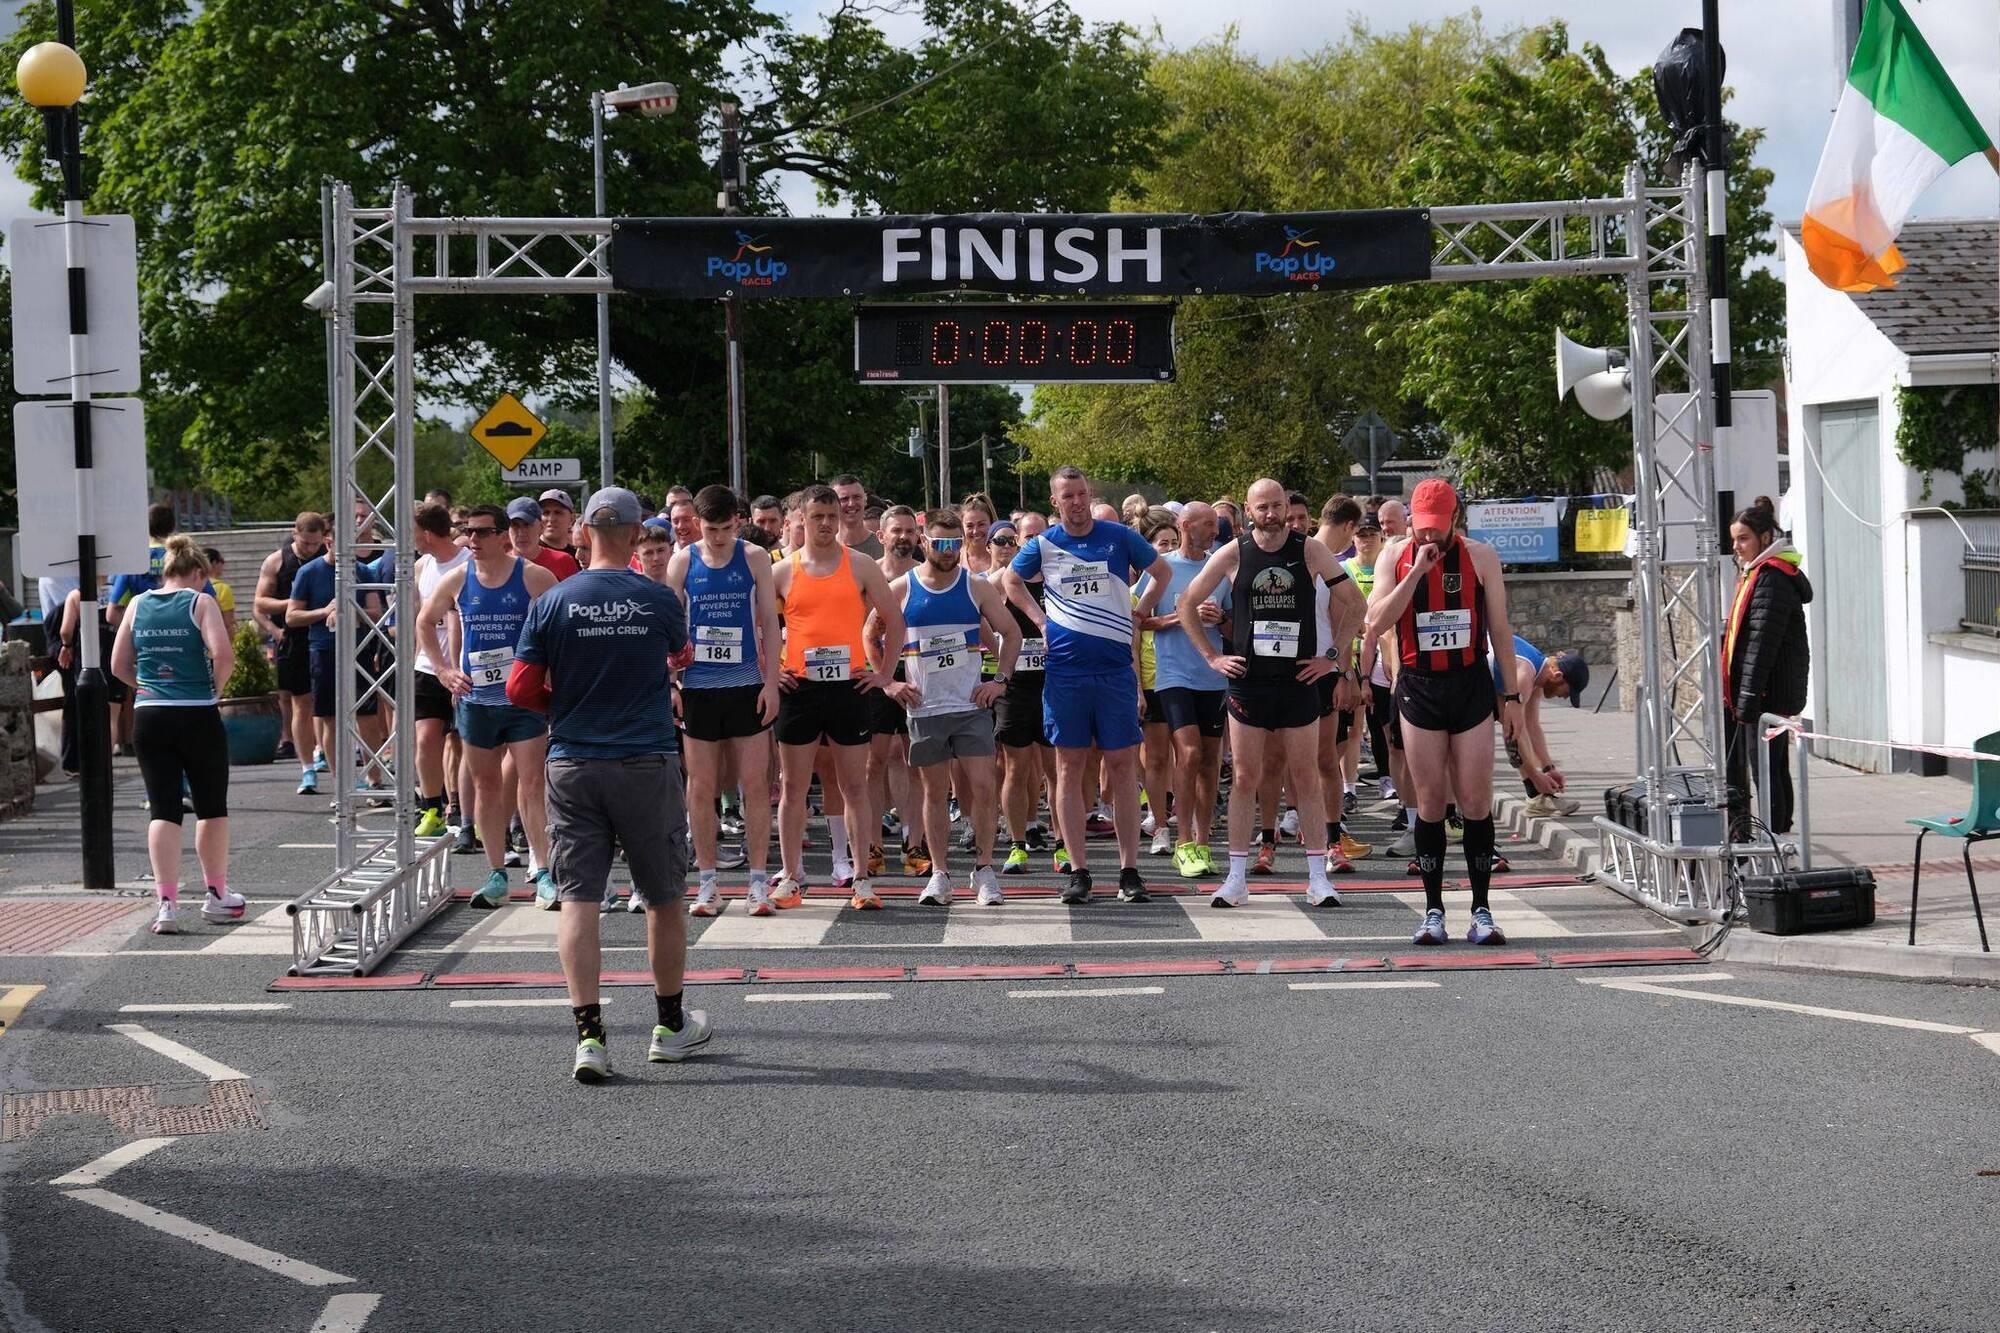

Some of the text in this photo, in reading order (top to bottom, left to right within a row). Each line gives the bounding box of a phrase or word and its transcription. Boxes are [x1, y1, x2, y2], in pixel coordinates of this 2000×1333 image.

[882, 227, 1162, 284] FINISH
[706, 256, 788, 282] Pop Up
[1255, 251, 1336, 278] Pop Up
[741, 278, 772, 286] RACES
[1289, 272, 1320, 280] RACES
[932, 320, 1135, 366] 0:00:00
[518, 463, 563, 477] RAMP
[1484, 506, 1541, 515] ATTENTION!
[1483, 534, 1544, 547] xenon
[1072, 580, 1099, 596] 214
[720, 591, 747, 600] BUIDHE
[1263, 594, 1296, 605] COLLAPSE
[568, 601, 629, 620] Pop Up
[730, 601, 741, 609] AC
[464, 613, 523, 622] SLIABH BUIDHE
[707, 610, 733, 619] FERNS
[470, 623, 516, 632] ROVERS AC
[576, 625, 649, 637] TIMING CREW
[479, 632, 506, 640] FERNS
[1430, 631, 1457, 647] 211
[705, 646, 732, 660] 184
[1272, 641, 1281, 654] 4
[937, 653, 955, 668] 26
[484, 668, 503, 682] 92
[816, 665, 841, 679] 121
